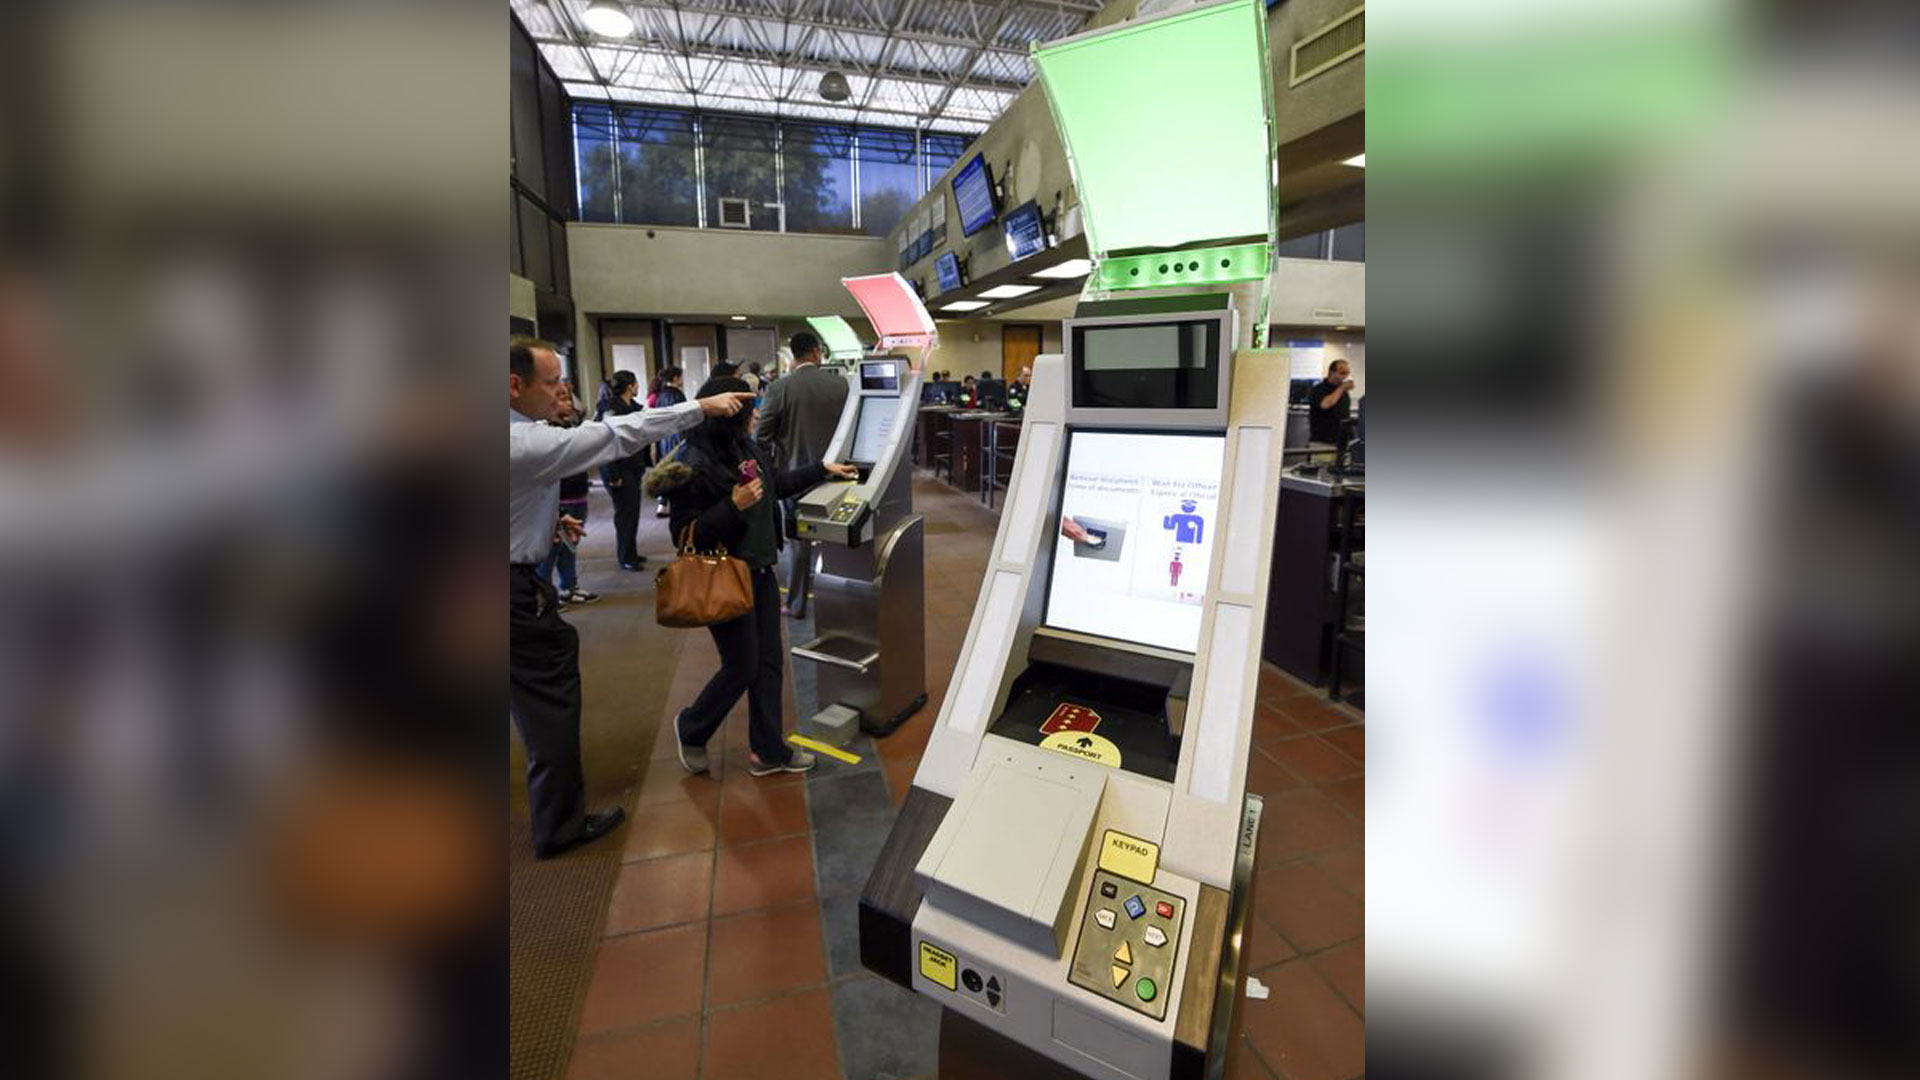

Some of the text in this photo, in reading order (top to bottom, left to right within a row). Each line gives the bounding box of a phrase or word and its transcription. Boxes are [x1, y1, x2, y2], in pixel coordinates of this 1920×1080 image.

[1057, 743, 1102, 760] PASSPORT
[1243, 816, 1255, 848] LANE
[1111, 838, 1149, 857] KEYPAD
